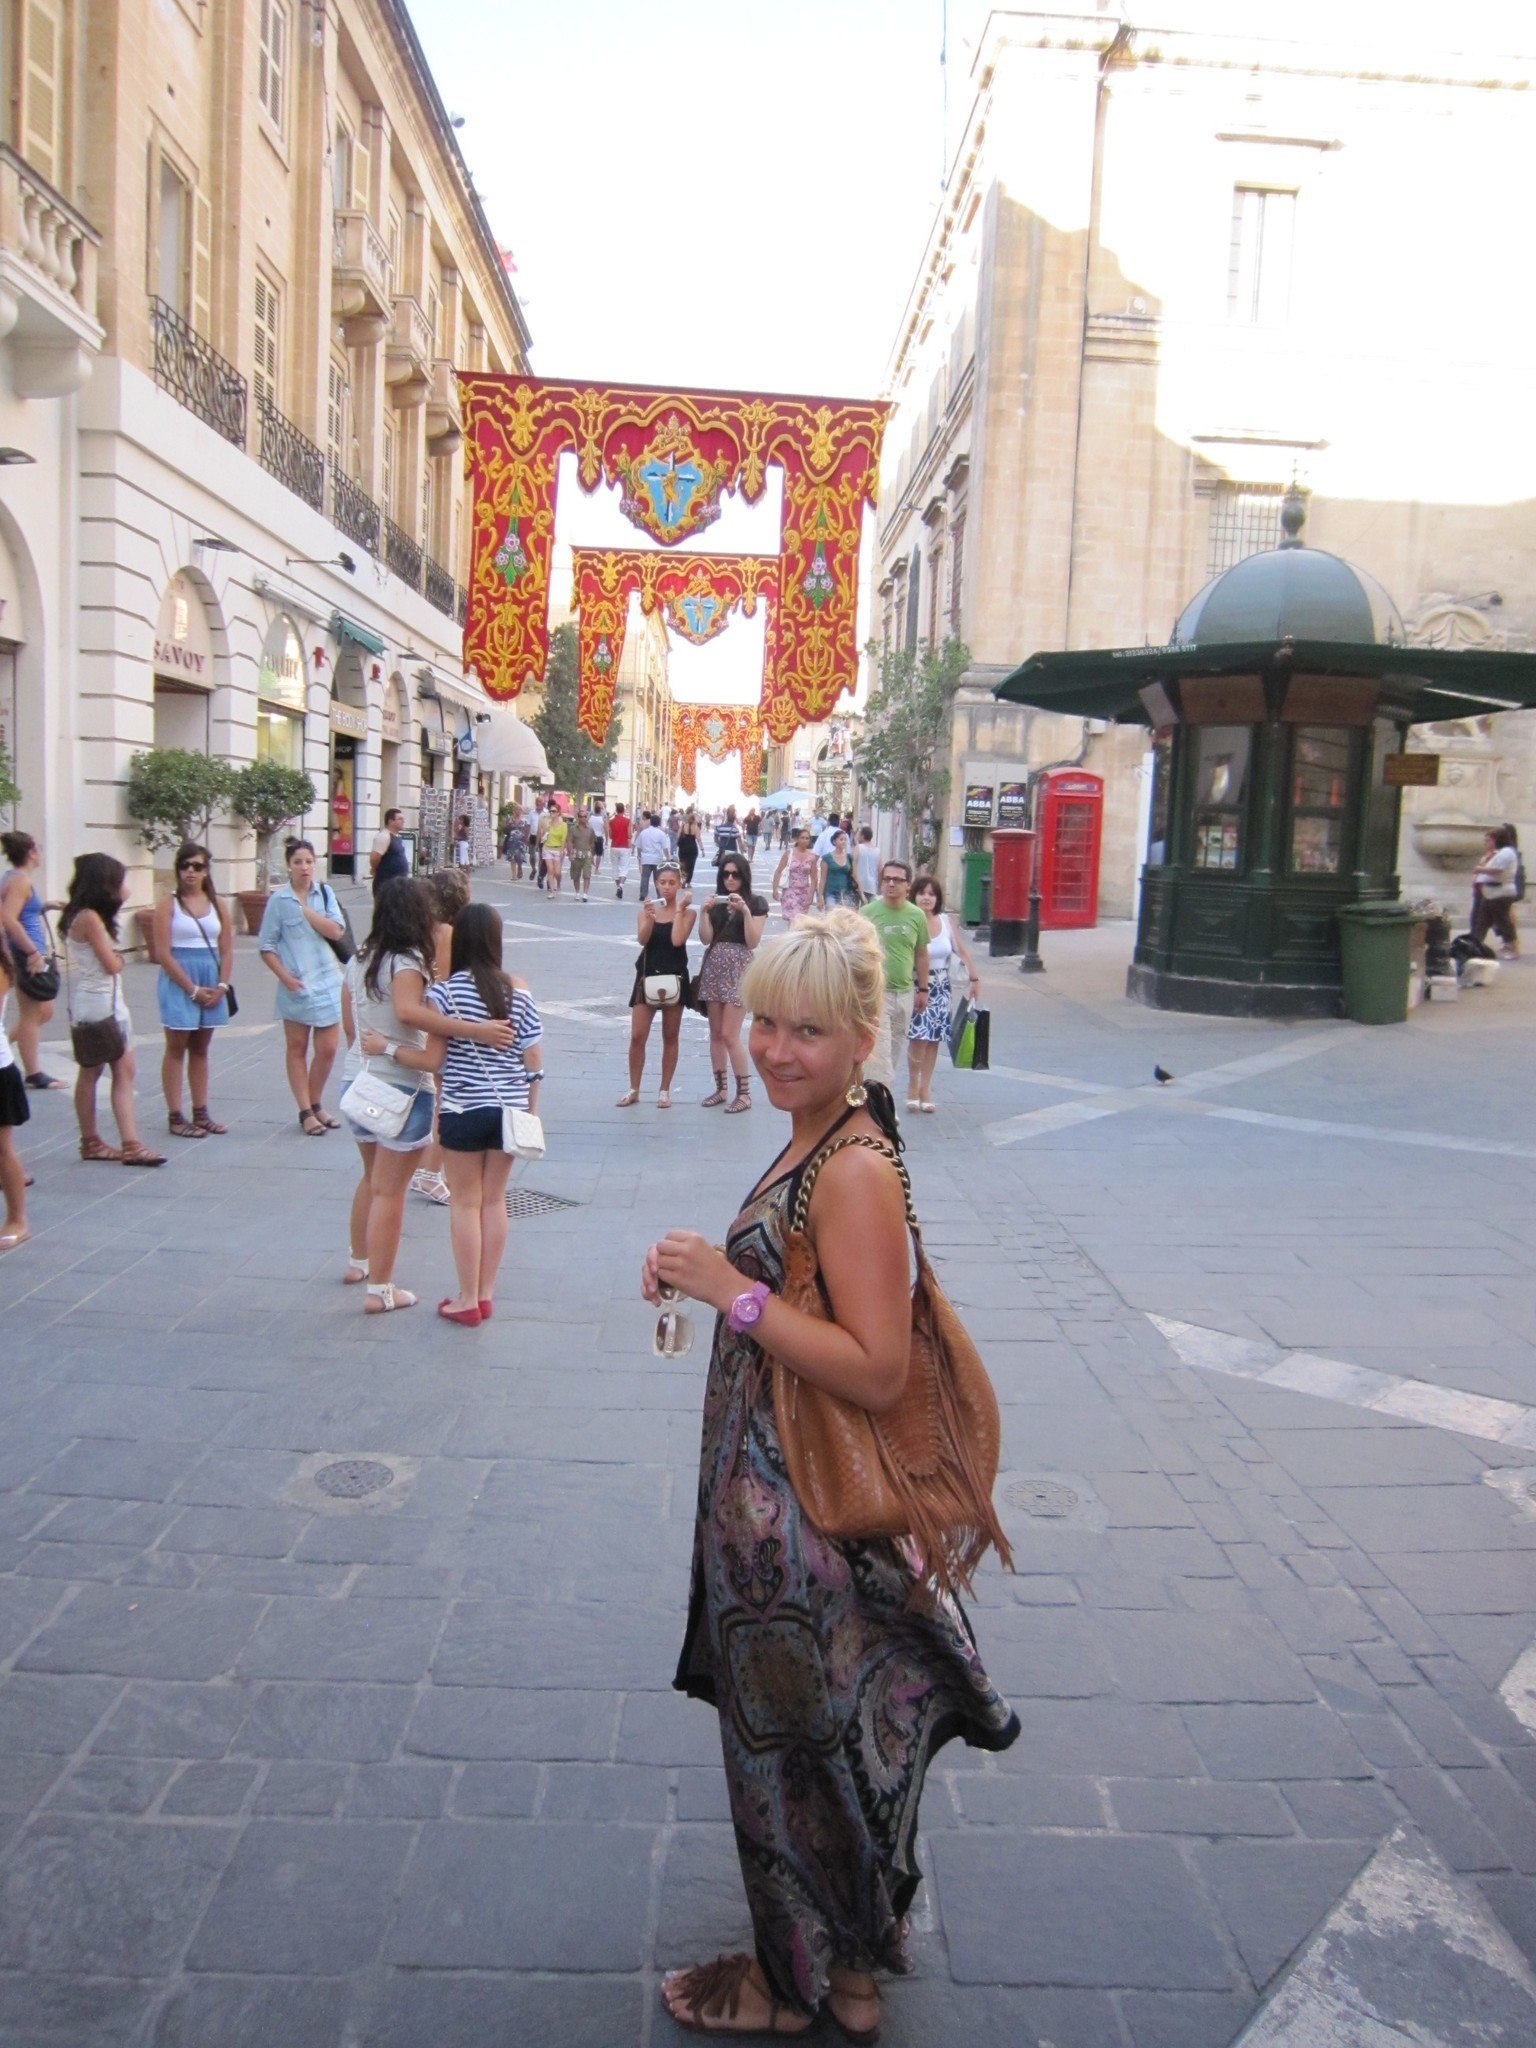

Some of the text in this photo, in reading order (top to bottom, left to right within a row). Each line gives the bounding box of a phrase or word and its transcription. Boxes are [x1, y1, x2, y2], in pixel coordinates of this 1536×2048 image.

[154, 640, 204, 672] SAVOY
[356, 715, 368, 732] SHOP
[335, 745, 352, 753] HOP
[966, 799, 991, 808] ABBA
[1000, 795, 1025, 804] ABBA
